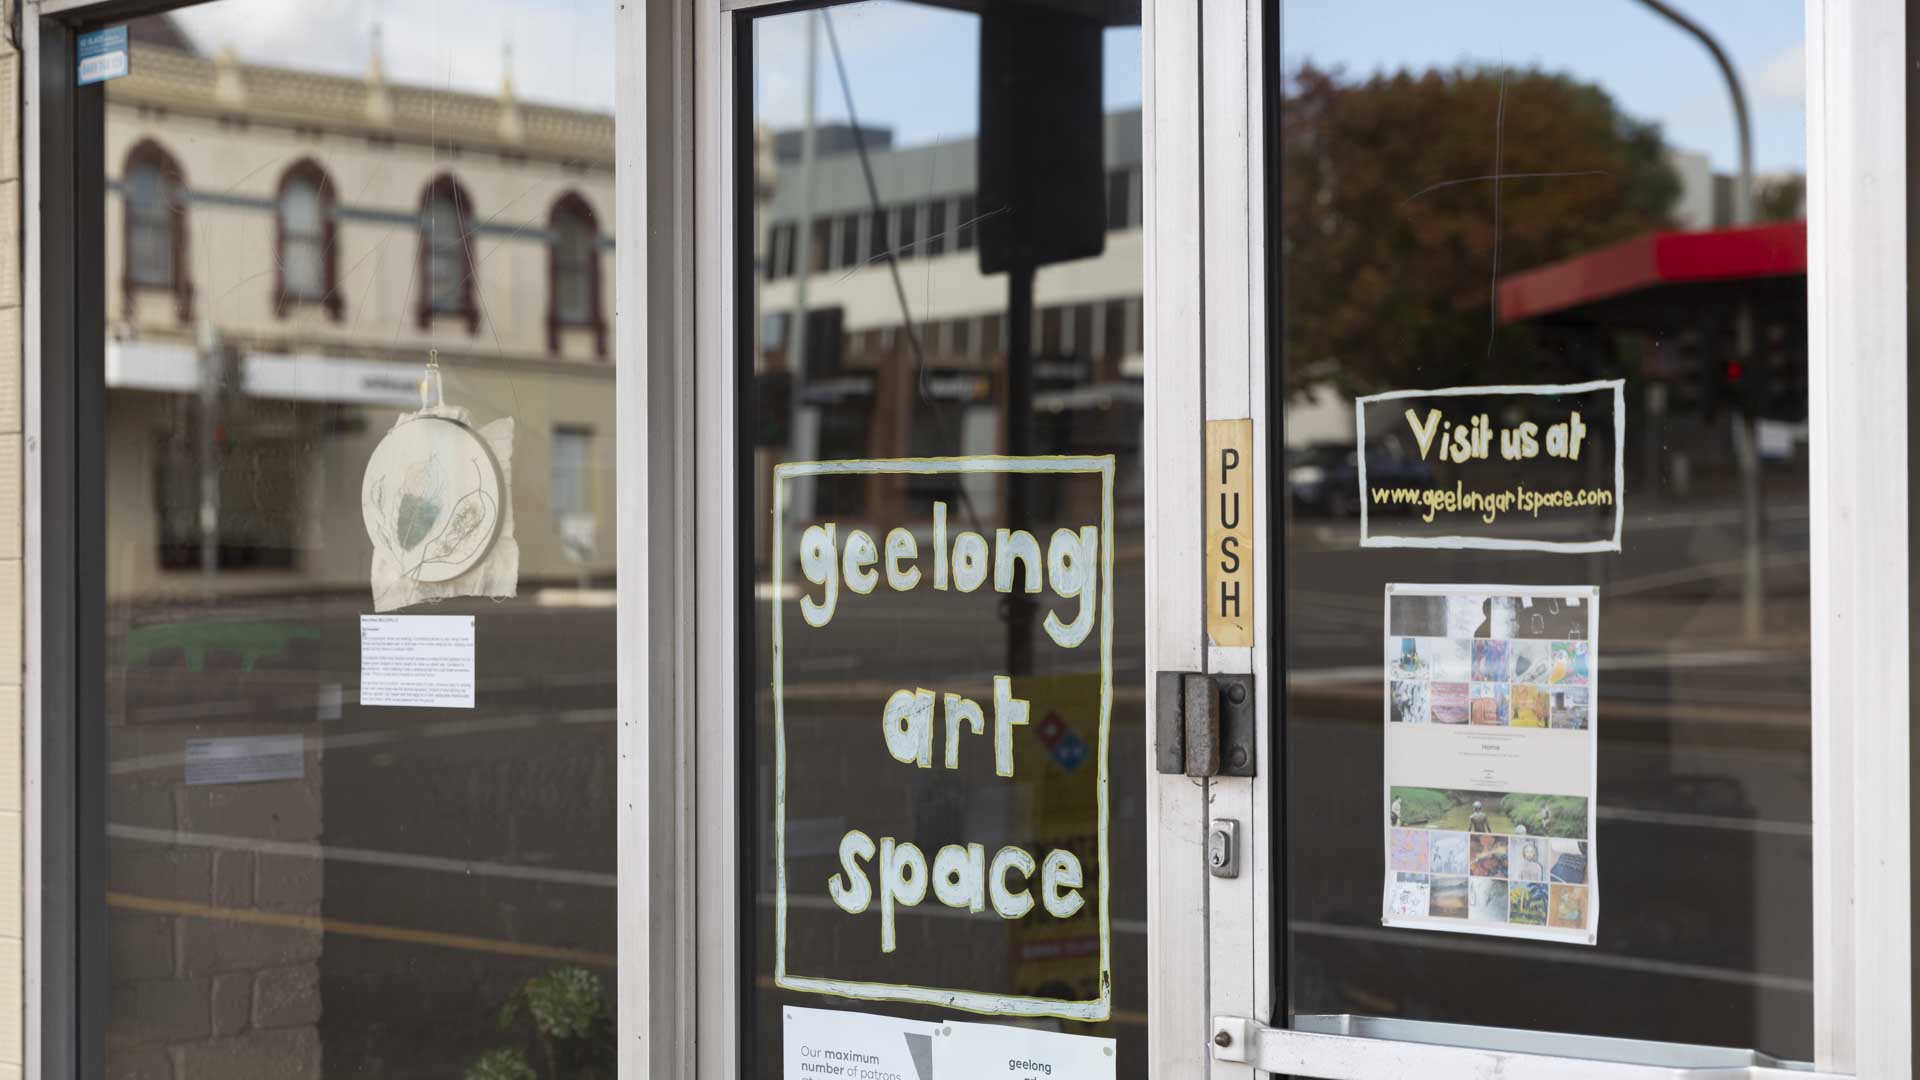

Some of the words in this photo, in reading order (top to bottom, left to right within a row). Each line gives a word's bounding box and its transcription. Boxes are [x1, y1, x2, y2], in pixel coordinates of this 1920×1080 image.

[1405, 408, 1493, 464] Visit
[1500, 421, 1540, 460] us
[1546, 411, 1586, 460] at
[1371, 480, 1613, 524] www.geelongartspace.com
[1220, 448, 1241, 617] PUSH
[799, 501, 1098, 648] geelong
[882, 675, 1031, 778] art
[828, 829, 1086, 953] space
[800, 1045, 821, 1058] Our
[824, 1049, 880, 1065] maximum
[800, 1062, 845, 1076] number
[847, 1066, 860, 1077] of
[860, 1069, 902, 1080] patrons
[1008, 1058, 1052, 1076] geelong
